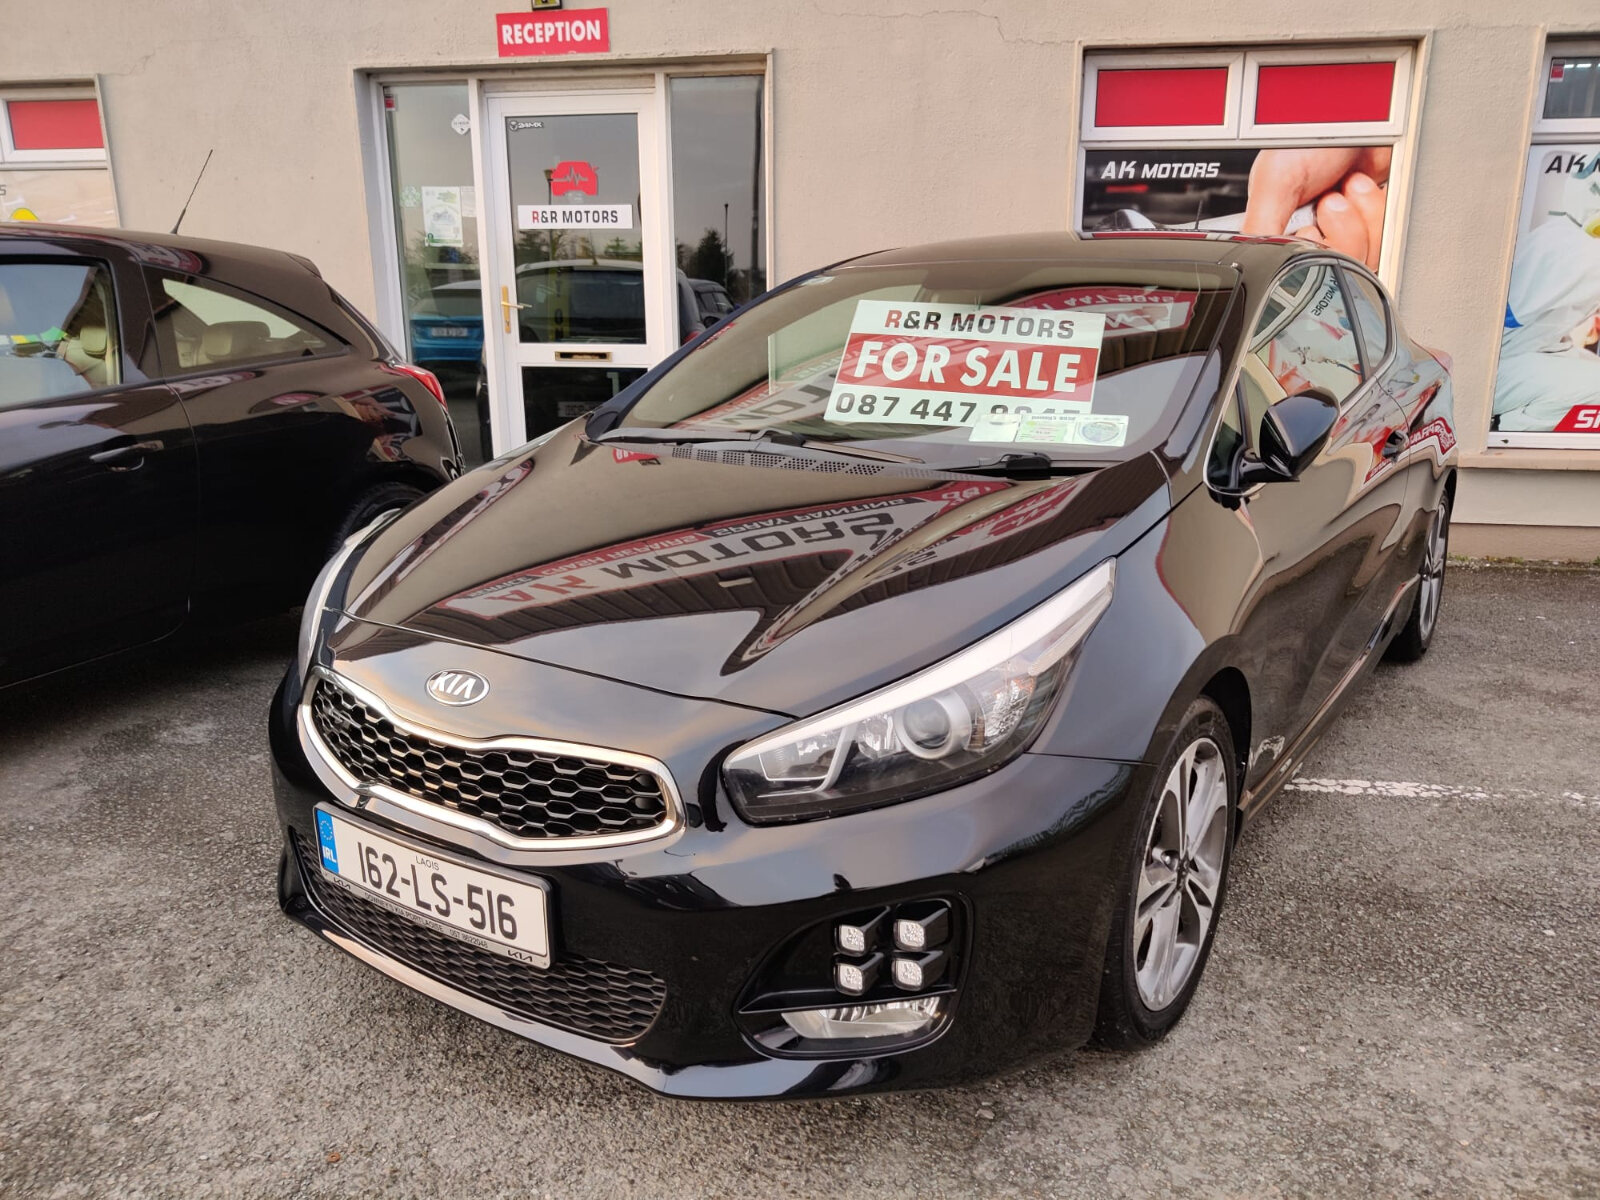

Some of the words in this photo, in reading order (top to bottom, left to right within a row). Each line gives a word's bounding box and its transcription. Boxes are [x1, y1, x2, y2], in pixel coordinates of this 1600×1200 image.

[501, 19, 601, 45] RECEPTION
[1100, 160, 1137, 179] AK
[1141, 162, 1222, 179] MOTORS
[1544, 154, 1588, 174] AK
[532, 210, 558, 223] R&R
[562, 210, 619, 223] MOTORS
[885, 310, 942, 332] R&R
[951, 312, 1075, 339] MOTORS
[854, 341, 951, 384] FOR
[960, 347, 1081, 393] SALE
[835, 392, 900, 417] 087
[910, 399, 977, 423] 447
[433, 670, 478, 699] KIA
[322, 845, 337, 863] IRL
[415, 855, 440, 871] LAOIS
[357, 841, 518, 941] 162-LS-516
[507, 949, 533, 963] KIA
